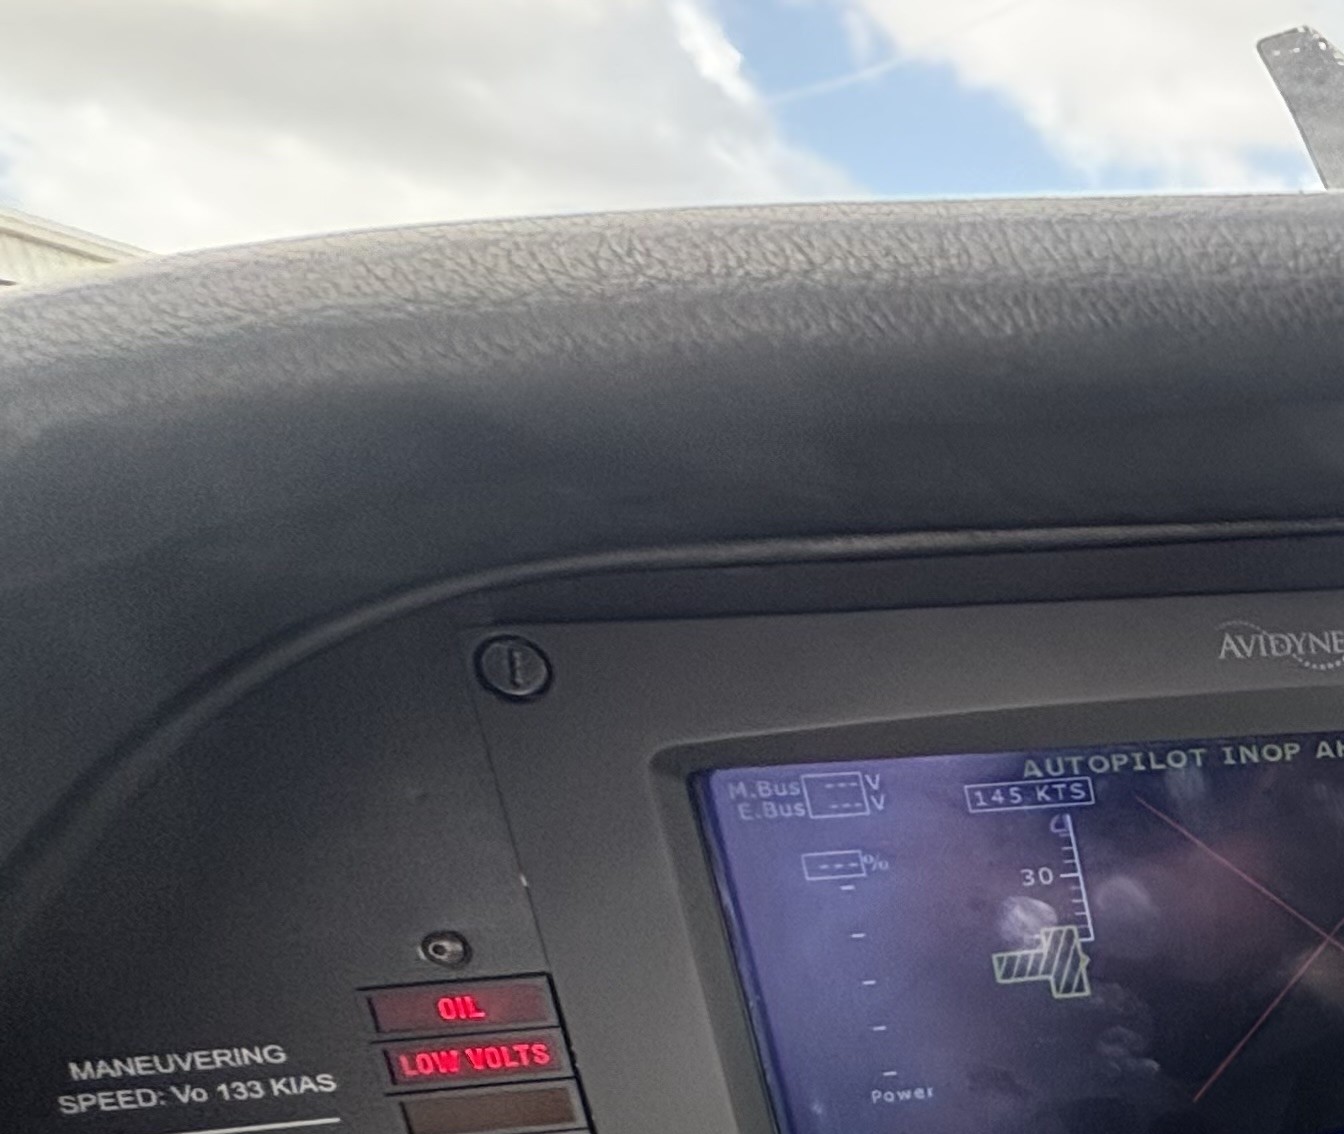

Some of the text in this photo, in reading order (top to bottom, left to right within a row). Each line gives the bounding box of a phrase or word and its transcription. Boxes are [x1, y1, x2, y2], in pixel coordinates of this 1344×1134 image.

[1023, 748, 1207, 778] AUTOPILOT
[1222, 742, 1301, 765] INOP
[974, 783, 1086, 807] 145 KTS
[438, 996, 485, 1020] OIL
[69, 1045, 287, 1081] MANEUVERING
[402, 1044, 550, 1076] LOW VOLTS
[58, 1073, 337, 1114] SPEED: Vo 133 KIAS
